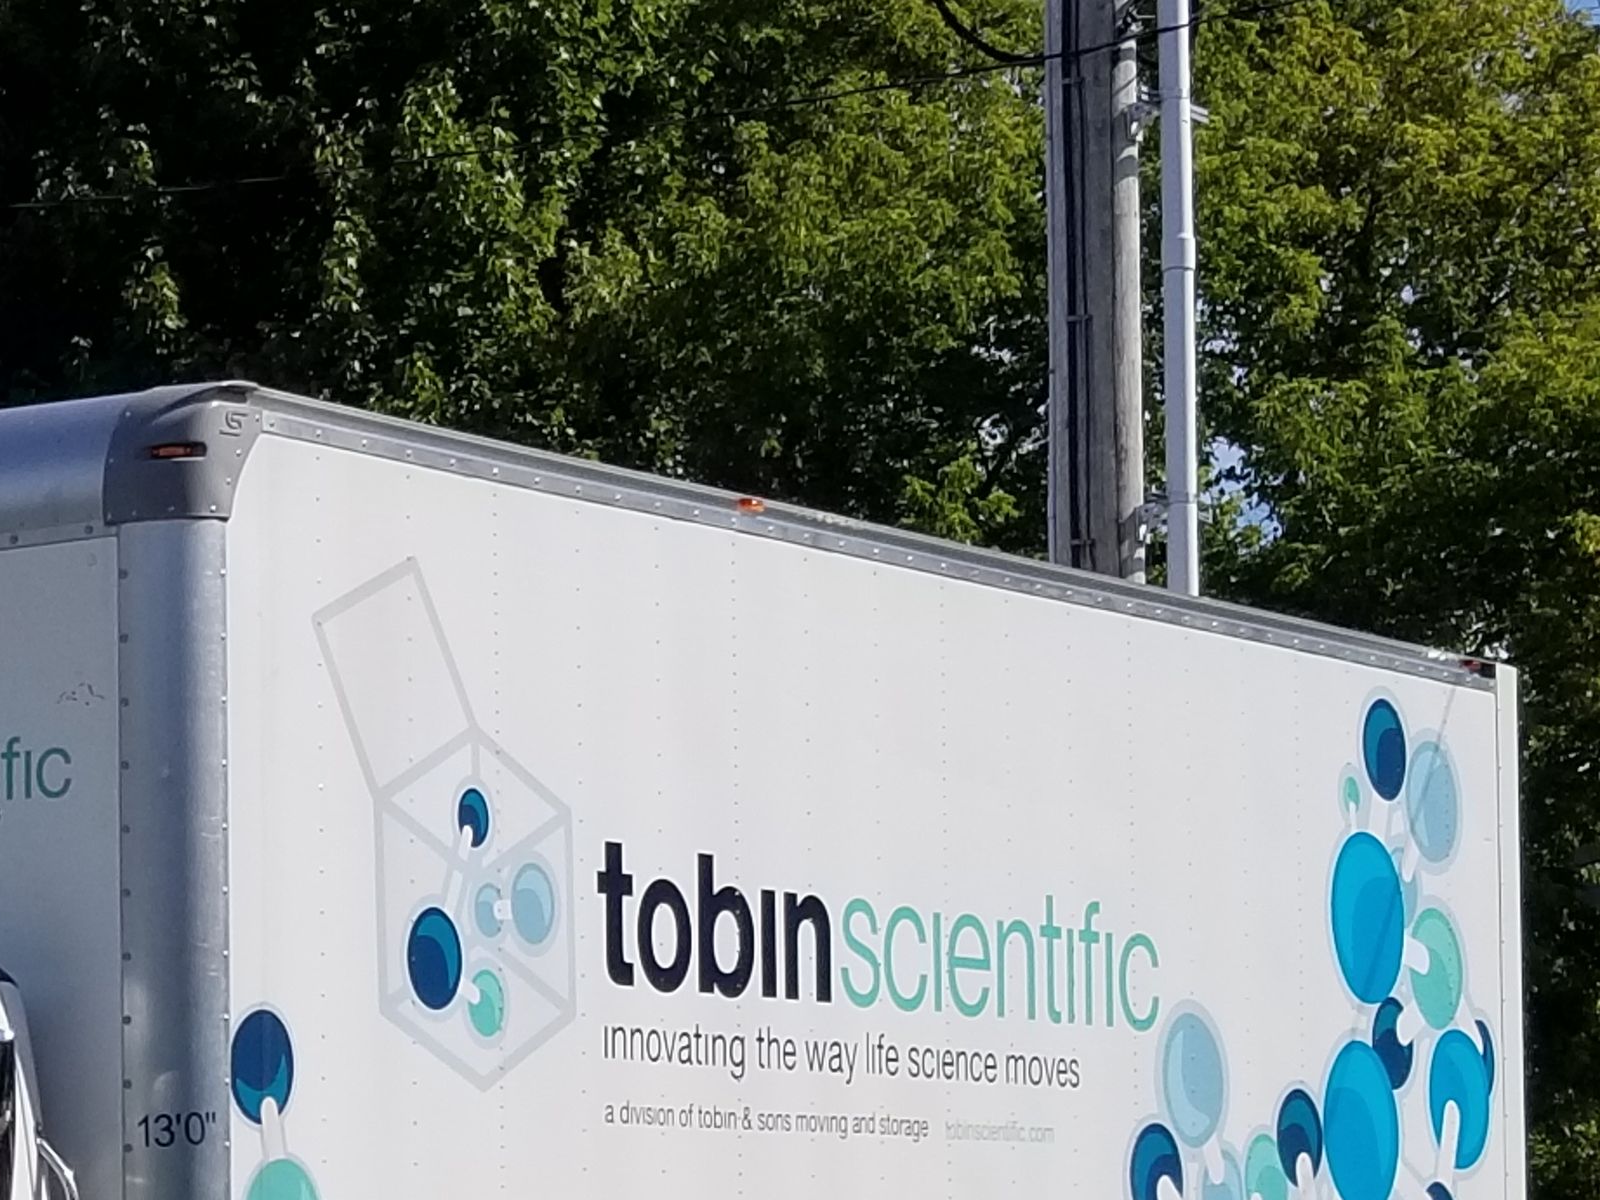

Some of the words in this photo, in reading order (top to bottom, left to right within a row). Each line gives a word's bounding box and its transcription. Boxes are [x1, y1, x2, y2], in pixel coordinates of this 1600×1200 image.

[603, 1023, 746, 1081] innovating
[755, 1025, 797, 1071] the
[804, 1039, 858, 1085] way
[866, 1032, 900, 1076] life
[907, 1045, 998, 1083] science
[1005, 1052, 1080, 1088] moves
[604, 1104, 615, 1124] a
[619, 1100, 674, 1127] division
[678, 1103, 694, 1128] of
[698, 1104, 738, 1130] tobin
[741, 1106, 753, 1131] &
[756, 1111, 792, 1133] sons
[795, 1112, 848, 1140] moving
[852, 1112, 875, 1135] and
[879, 1113, 929, 1143] storage
